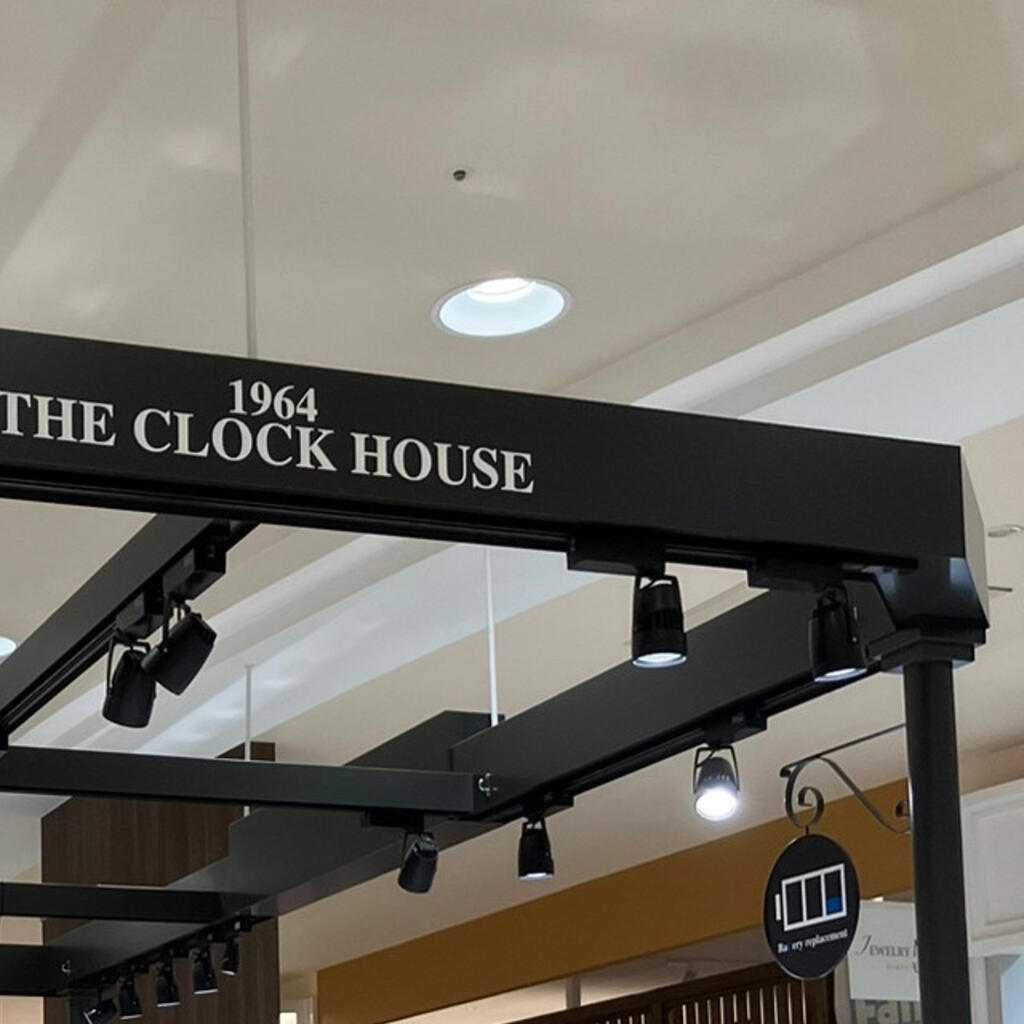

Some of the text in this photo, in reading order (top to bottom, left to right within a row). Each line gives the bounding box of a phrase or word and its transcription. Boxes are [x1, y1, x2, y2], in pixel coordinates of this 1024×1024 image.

[228, 379, 318, 422] 1964
[133, 408, 336, 471] CLOCK
[350, 432, 534, 494] HOUSE
